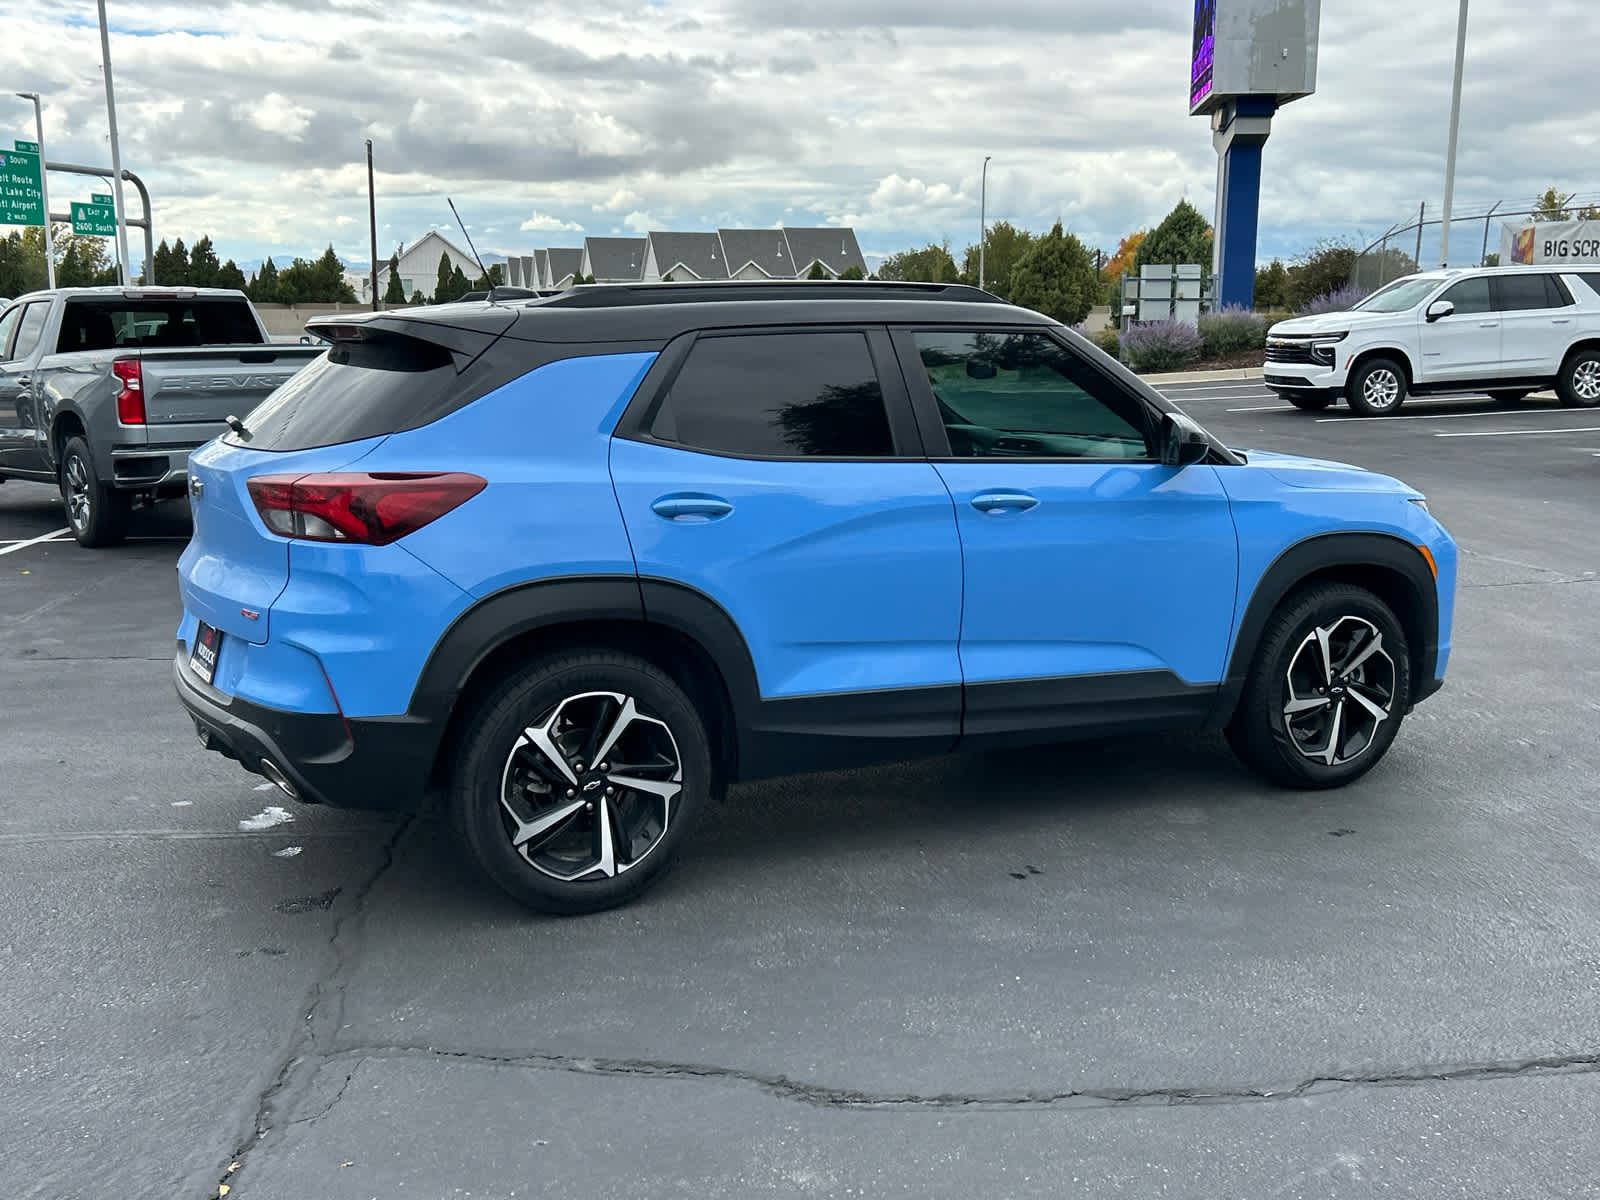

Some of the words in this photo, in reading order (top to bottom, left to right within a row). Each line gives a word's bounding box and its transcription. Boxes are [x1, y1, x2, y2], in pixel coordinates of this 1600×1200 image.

[12, 174, 33, 184] Route
[6, 187, 23, 197] Lake
[26, 188, 41, 200] City
[11, 199, 37, 211] Airport
[6, 212, 12, 221] 2
[76, 222, 93, 231] 2600
[95, 223, 114, 233] South
[1543, 239, 1568, 257] BIG
